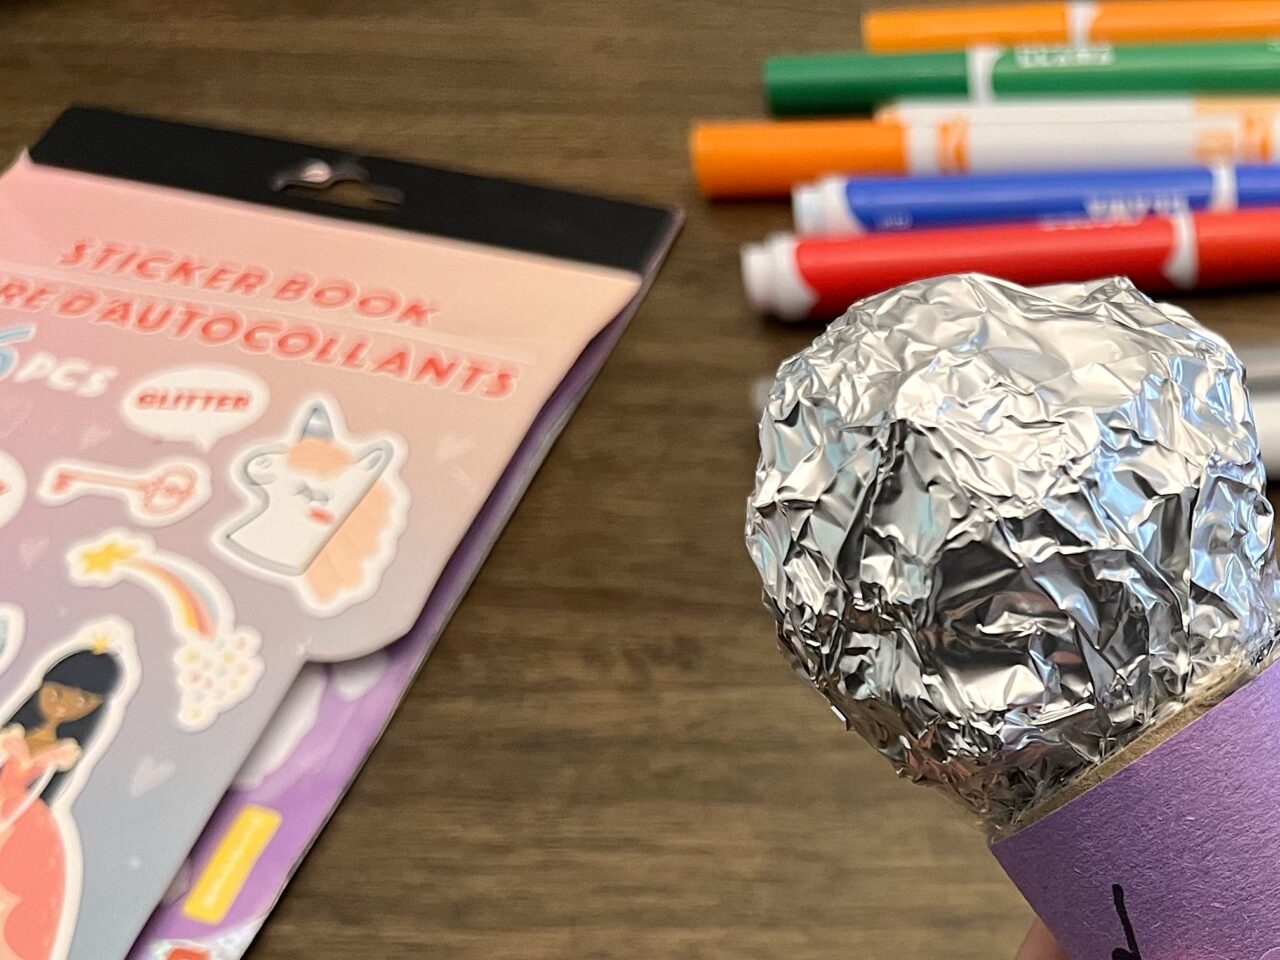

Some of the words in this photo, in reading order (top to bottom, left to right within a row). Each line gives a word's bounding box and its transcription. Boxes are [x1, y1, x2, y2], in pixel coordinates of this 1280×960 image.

[60, 239, 270, 297] STICKER
[271, 273, 441, 326] BOOK
[137, 387, 252, 412] GLITTER
